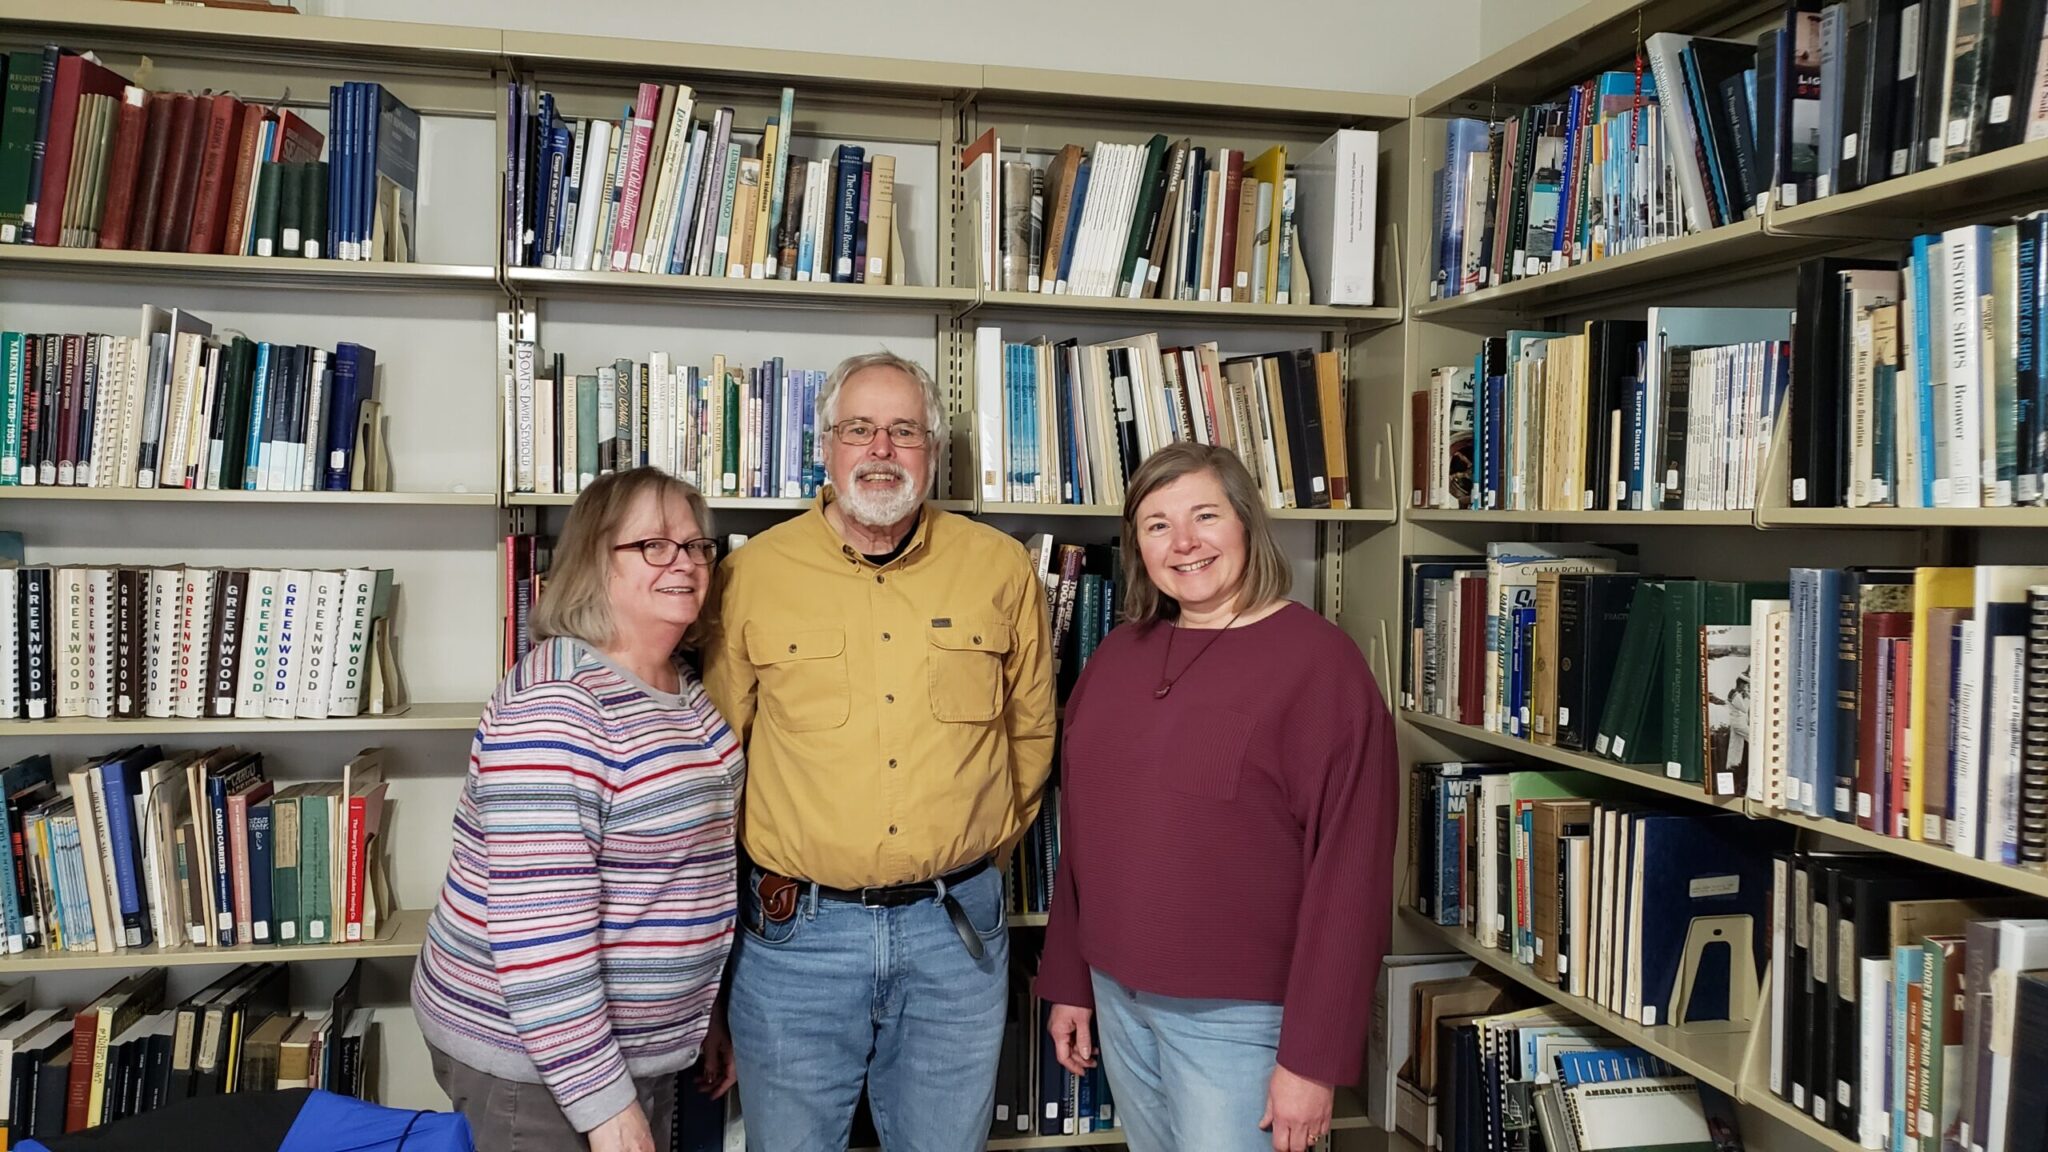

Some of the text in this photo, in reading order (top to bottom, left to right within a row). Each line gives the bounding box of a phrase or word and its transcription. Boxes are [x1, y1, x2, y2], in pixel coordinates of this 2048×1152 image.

[10, 74, 41, 82] REGISTE
[552, 155, 560, 172] Songs
[1179, 149, 1195, 192] MARINAS
[1446, 132, 1455, 178] AMERICA
[1561, 132, 1569, 163] LAKES
[620, 131, 647, 229] All About Old Buildings
[723, 148, 739, 218] LUMBERJACK LINGO
[844, 188, 855, 209] Great
[846, 173, 856, 188] The
[545, 217, 555, 251] Lumberman
[842, 210, 853, 232] Lakes
[1951, 243, 1967, 441] HISTORIC SHIPS Brouwer
[2017, 238, 2035, 423] THE HISTORY OF SHIPS Kemp
[7, 340, 19, 395] NAMESAKES
[24, 338, 32, 391] NAMESAKES
[44, 336, 54, 381] NAMESAKES
[64, 337, 74, 384] NAMESAKES
[85, 337, 94, 383] NAMESAKES
[22, 393, 30, 407] OF
[29, 391, 39, 432] THE NEW
[125, 394, 133, 429] BOATS
[518, 350, 533, 466] BOATS DAVID SEYBOLD
[619, 371, 629, 432] SOO CANAL!
[1177, 389, 1190, 430] IRON ORE
[1855, 350, 1869, 448] Marine Salvage Operations
[20, 429, 29, 458] LAKES
[1633, 390, 1643, 471] SKIPPER'S CHALLENGE
[1057, 578, 1071, 605] TOOL
[1062, 579, 1077, 632] THE GREAT
[1797, 581, 1807, 639] The Shipbuilding
[28, 582, 43, 691] GREENWOOD
[68, 583, 82, 690] GREENWOOD
[88, 583, 96, 690] GREENWOOD
[119, 584, 129, 691] GREENWOOD
[150, 584, 163, 691] GREENWOOD
[180, 583, 194, 690] GREENWOOD
[218, 584, 239, 690] GREENWOOD
[252, 585, 273, 692] GREENWOOD
[275, 583, 297, 691] GREENWOOD
[307, 585, 328, 691] GREENWOOD
[345, 584, 368, 690] GREENWOOD
[517, 587, 528, 653] LIGHTHOUSE PARADOX
[1674, 620, 1682, 663] AMERICAN
[1672, 668, 1680, 713] PRACTICAL
[2012, 647, 2022, 694] Confessions
[1701, 695, 1706, 704] on
[2011, 696, 2020, 704] of
[1957, 630, 1974, 838] Smith Vanguard of Empire Oxford
[92, 791, 104, 815] GREAT
[98, 841, 109, 860] SAGA
[215, 807, 226, 873] CARGO CARRIERS
[1918, 952, 1933, 1109] WOODEN BOAT REPAIR MANUAL
[1584, 1083, 1698, 1097] AMERICA'S LIGHTHOUSES
